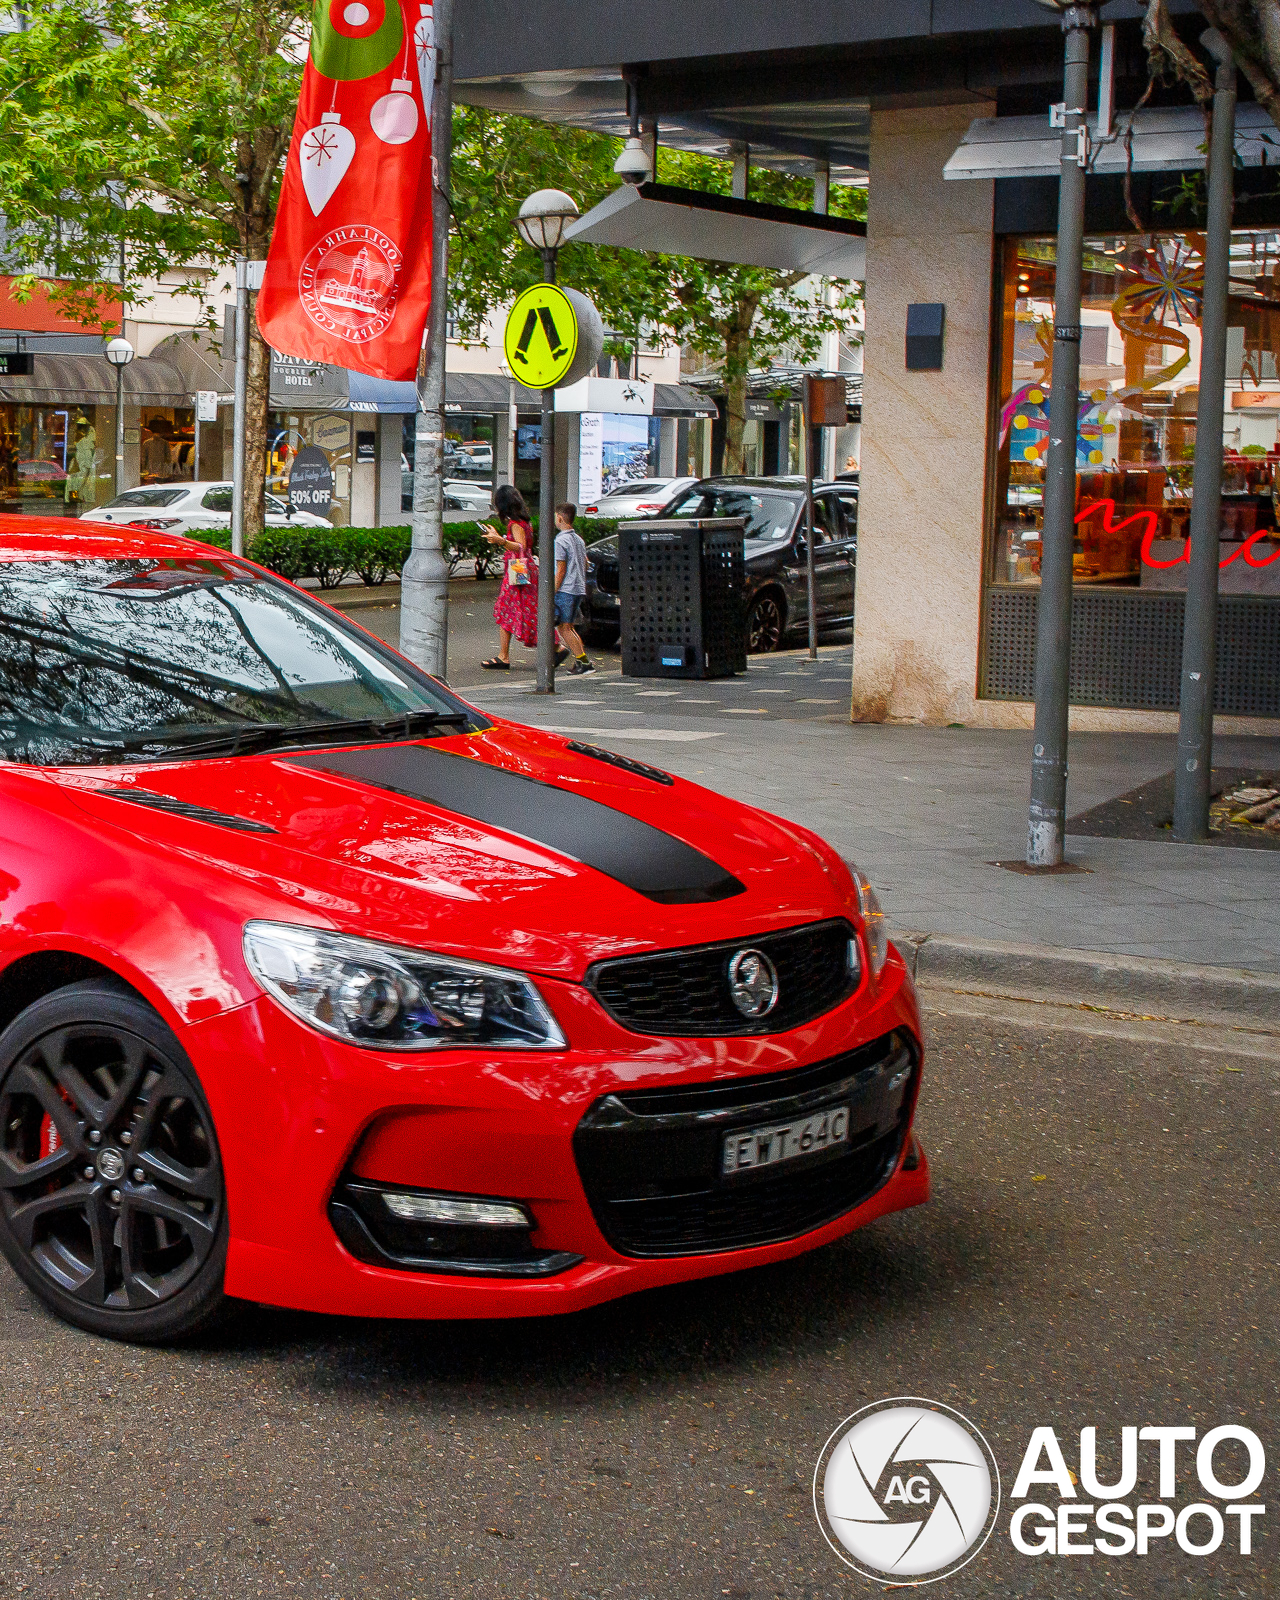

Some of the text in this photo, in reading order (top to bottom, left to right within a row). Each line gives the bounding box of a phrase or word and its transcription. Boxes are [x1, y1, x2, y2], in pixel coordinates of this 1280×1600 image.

[274, 366, 306, 376] DOUBLE
[285, 375, 313, 387] HOTEL
[350, 401, 379, 411] GAZMAN
[290, 489, 331, 504] 50% OFF
